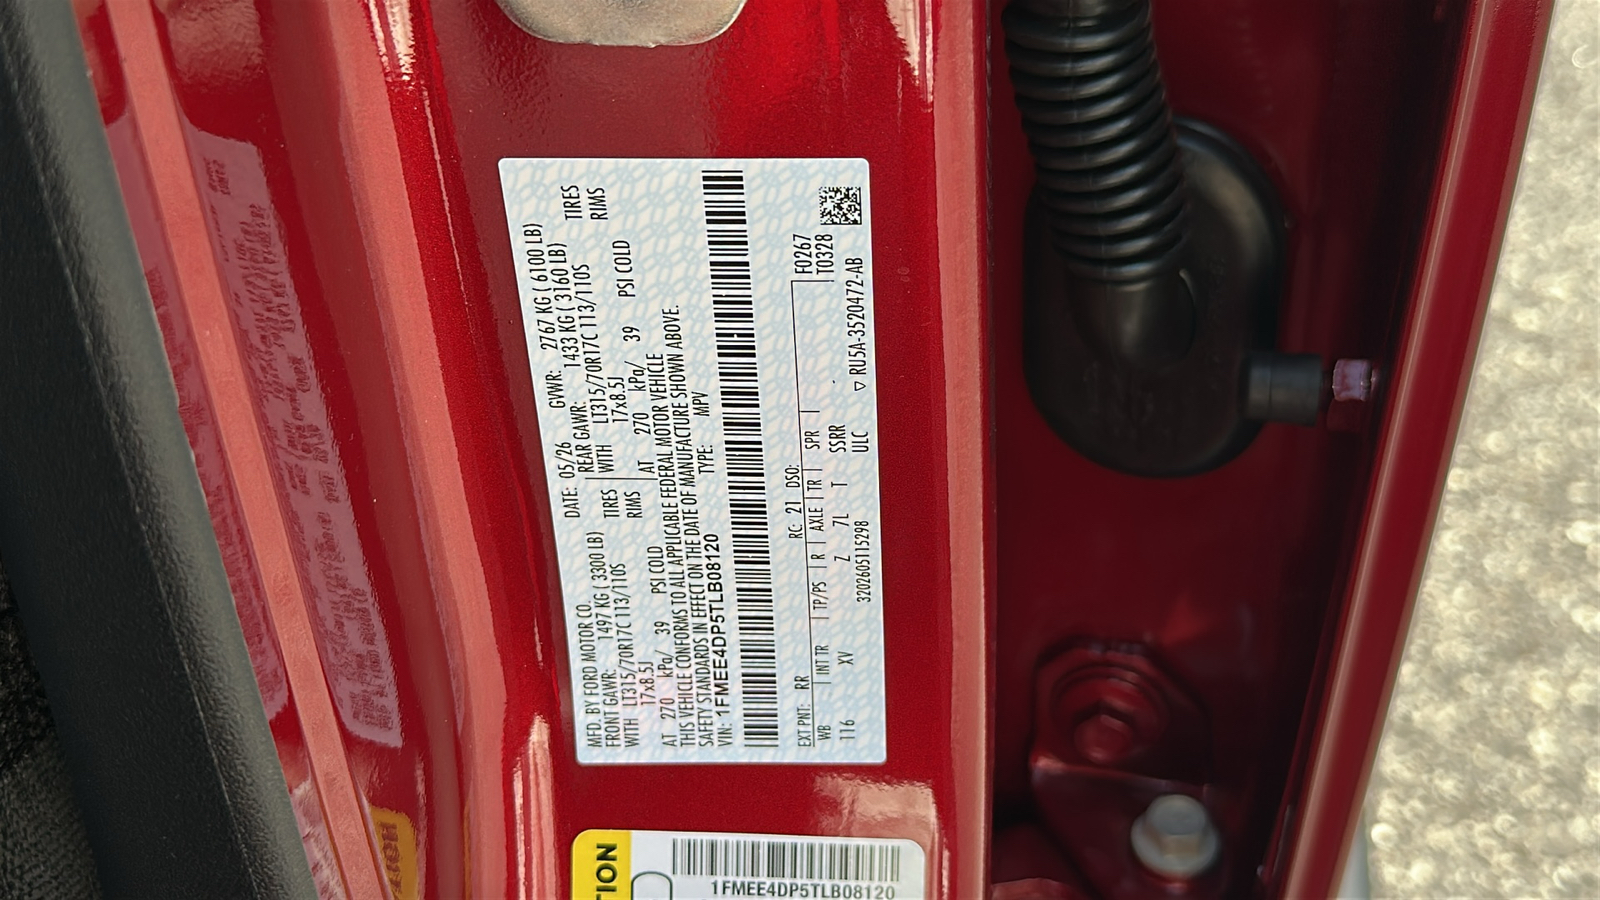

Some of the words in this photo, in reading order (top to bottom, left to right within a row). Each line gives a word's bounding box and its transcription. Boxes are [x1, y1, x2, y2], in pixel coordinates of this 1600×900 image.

[560, 185, 583, 220] TIRES
[586, 188, 608, 220] RIMS
[522, 223, 543, 244] LB)
[547, 243, 567, 263] LB)
[612, 240, 633, 273] COLD
[793, 234, 813, 274] F0267
[814, 234, 834, 275] T0328
[616, 279, 636, 297] PSI
[533, 297, 553, 313] KG
[845, 258, 867, 375] RU5A-3520472-AB
[537, 319, 558, 350] 2767
[557, 316, 576, 332] KG
[622, 326, 640, 342] 39
[662, 305, 683, 350] ABOVE.
[560, 337, 581, 368] 1433
[545, 370, 566, 408] GVWR:
[624, 361, 646, 391] kPa/
[646, 354, 667, 401] VEHICLE
[667, 354, 687, 398] SHOWN
[607, 377, 629, 423] 17x8.5J
[691, 391, 710, 417] MPV
[570, 402, 590, 440] GAWR:
[632, 413, 651, 435] 270
[651, 405, 672, 447] MOTOR
[671, 403, 696, 487] MANUFACTURE
[804, 431, 820, 449] SPR
[828, 425, 846, 453] SSRR
[851, 432, 869, 452] ULC
[554, 442, 576, 479] 05/26
[575, 444, 594, 472] REAR
[595, 445, 614, 473] WITH
[637, 460, 655, 474] AT
[696, 445, 715, 474] TYPE:
[656, 451, 677, 498] FEDERAL
[784, 465, 800, 488] DSO:
[807, 479, 822, 491] TR
[561, 487, 580, 518] DATE:
[600, 489, 620, 518] TIRES
[623, 491, 643, 518] RIMS
[680, 491, 697, 505] OF
[785, 502, 802, 514] 21
[682, 509, 700, 536] DATE
[788, 524, 803, 539] RC:
[808, 507, 824, 532] AXLE
[832, 513, 849, 527] 7L
[586, 532, 604, 549] LB)
[661, 503, 684, 566] APPLICABLE
[647, 546, 665, 574] COLD
[684, 540, 702, 560] THE
[854, 521, 871, 602] 3202605115298
[668, 570, 685, 588] ALL
[687, 564, 704, 579] ON
[650, 578, 667, 594] PSI
[670, 592, 687, 605] TO
[811, 582, 828, 610] TP/PS
[575, 601, 592, 618] CO.
[593, 593, 610, 608] KG
[688, 583, 707, 618] EFFECT
[595, 613, 613, 640] 1497
[654, 621, 670, 635] 39
[671, 609, 691, 669] CONFORMS
[692, 623, 708, 633] IN
[703, 534, 730, 717] 1FMEE4DP5TLB08120
[578, 622, 596, 662] MOTOR
[815, 645, 829, 656] TR
[655, 650, 674, 677] kPa/
[692, 638, 712, 703] STANDARDS
[815, 659, 829, 675] INT
[838, 651, 853, 665] XV
[582, 666, 599, 696] FORD
[601, 669, 618, 706] GAWR:
[638, 661, 656, 705] 17x8.5J
[794, 676, 809, 689] RR
[584, 700, 601, 714] BY
[659, 698, 676, 720] 270
[676, 674, 694, 718] VEHICLE
[697, 707, 714, 747] SAFETY
[796, 703, 811, 725] PNT:
[586, 719, 602, 747] MFD.
[603, 711, 621, 747] FRONT
[623, 719, 639, 748] WITH
[661, 733, 677, 747] AT
[679, 722, 696, 747] THIS
[717, 724, 733, 747] VIN:
[797, 729, 814, 747] EXT
[817, 725, 831, 740] WB
[839, 720, 855, 740] 116
[711, 879, 895, 900] 1FMEE4DP5TLB08120
